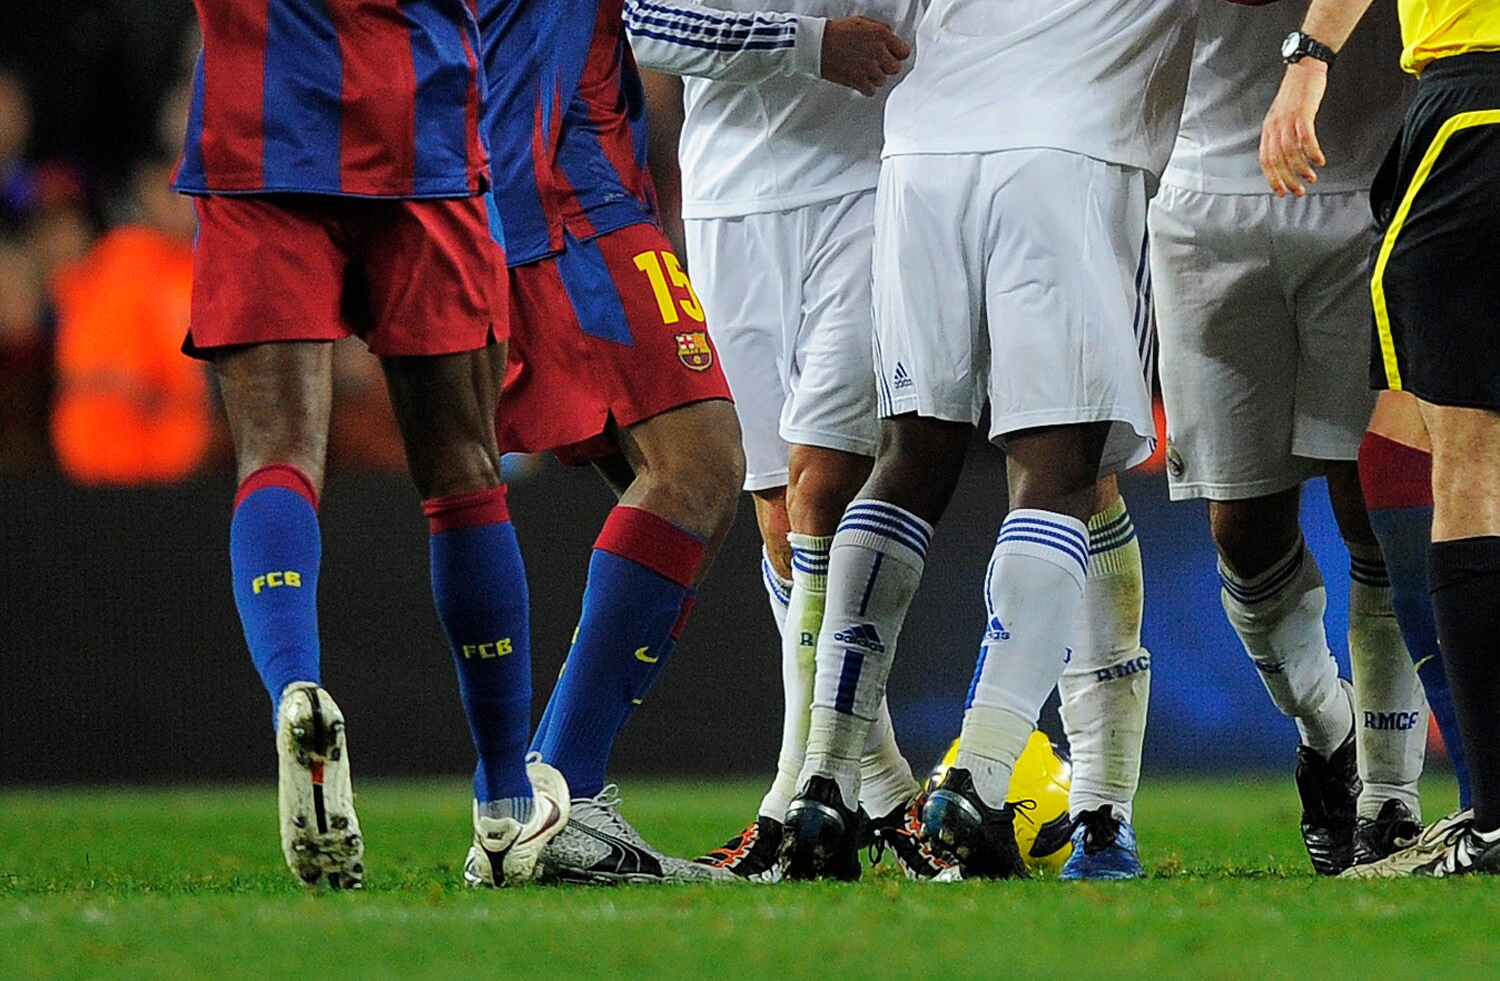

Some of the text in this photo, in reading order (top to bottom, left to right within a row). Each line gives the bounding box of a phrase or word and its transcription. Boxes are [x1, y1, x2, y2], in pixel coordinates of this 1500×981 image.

[633, 250, 705, 325] 15
[252, 571, 301, 595] FCB
[462, 637, 513, 659] FCB
[1364, 711, 1419, 731] RMCF
